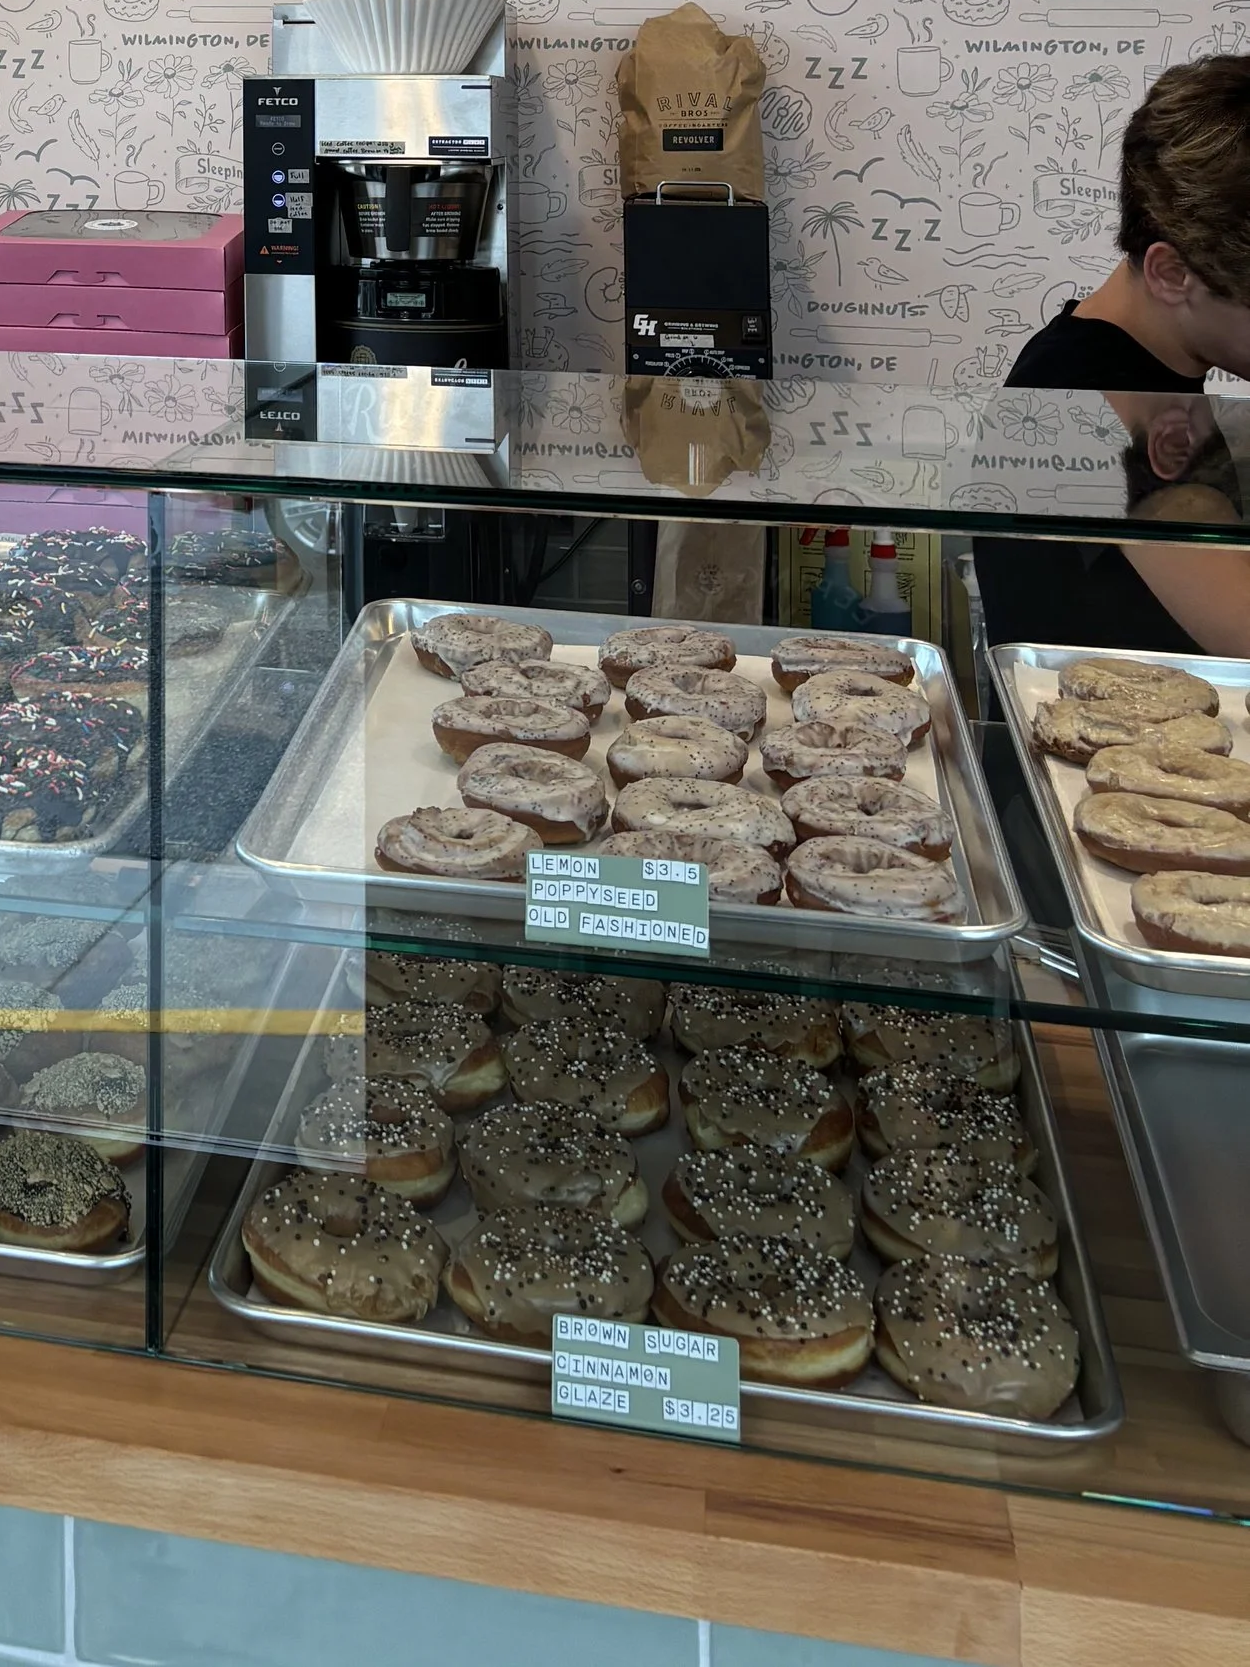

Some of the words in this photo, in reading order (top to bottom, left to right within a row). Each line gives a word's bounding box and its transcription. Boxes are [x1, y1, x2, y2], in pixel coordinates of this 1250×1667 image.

[240, 33, 271, 48] DE
[1116, 39, 1146, 55] DE
[257, 97, 299, 106] FETCO
[656, 92, 733, 112] RIVAL
[680, 109, 709, 117] BROS
[672, 135, 715, 144] REVOLVER
[196, 156, 244, 180] Sleepin
[870, 356, 898, 372] DE
[530, 856, 599, 877] LEMON
[643, 860, 699, 883] $3.5
[533, 881, 658, 909] POPPYSEED
[527, 907, 569, 927] OLD
[580, 915, 708, 946] FASHIONED
[558, 1318, 629, 1347] BROWN
[645, 1332, 719, 1359] SUGAR
[555, 1353, 670, 1388] CINNAMON
[558, 1384, 629, 1411] GLAZE
[663, 1399, 738, 1427] $3.25
